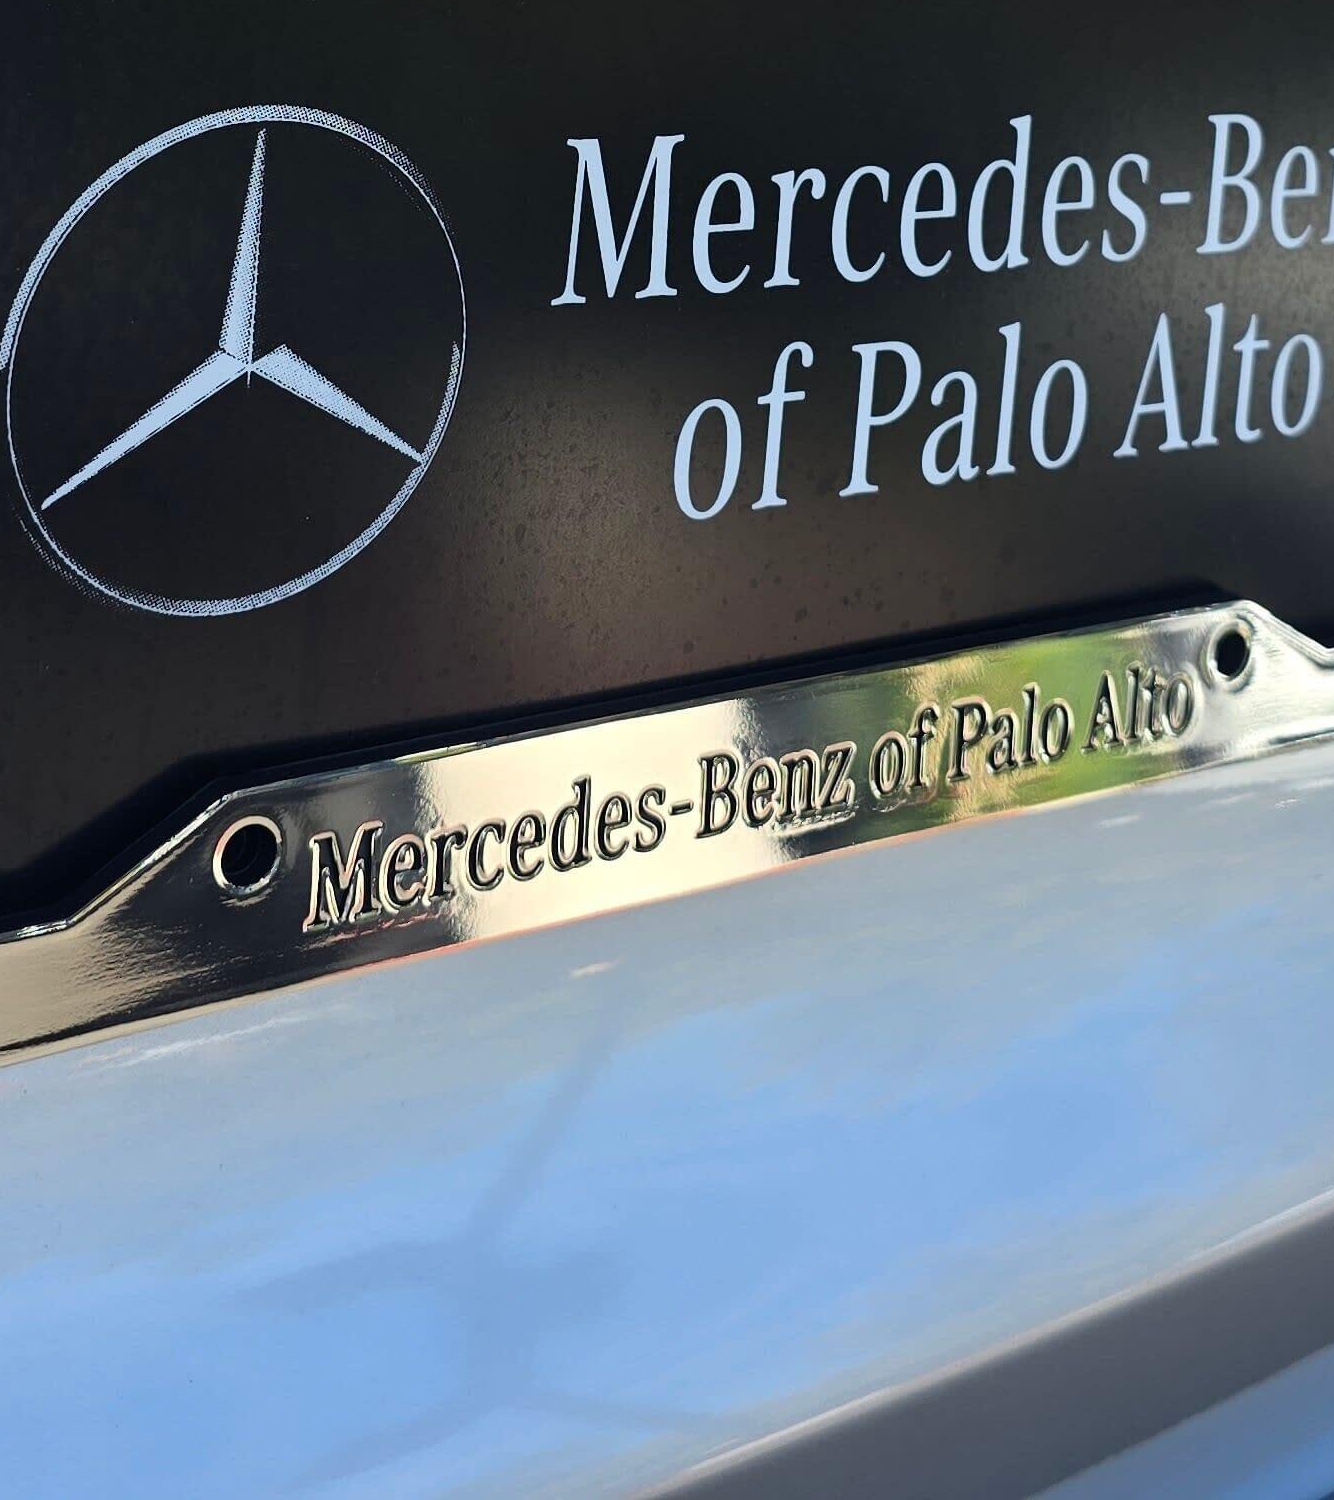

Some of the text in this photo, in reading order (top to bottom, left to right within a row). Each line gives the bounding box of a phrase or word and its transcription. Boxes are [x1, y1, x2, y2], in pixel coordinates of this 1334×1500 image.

[672, 302, 1324, 521] of Palo Alto
[301, 659, 1197, 932] Mercedes-Benz of Palo Alto
